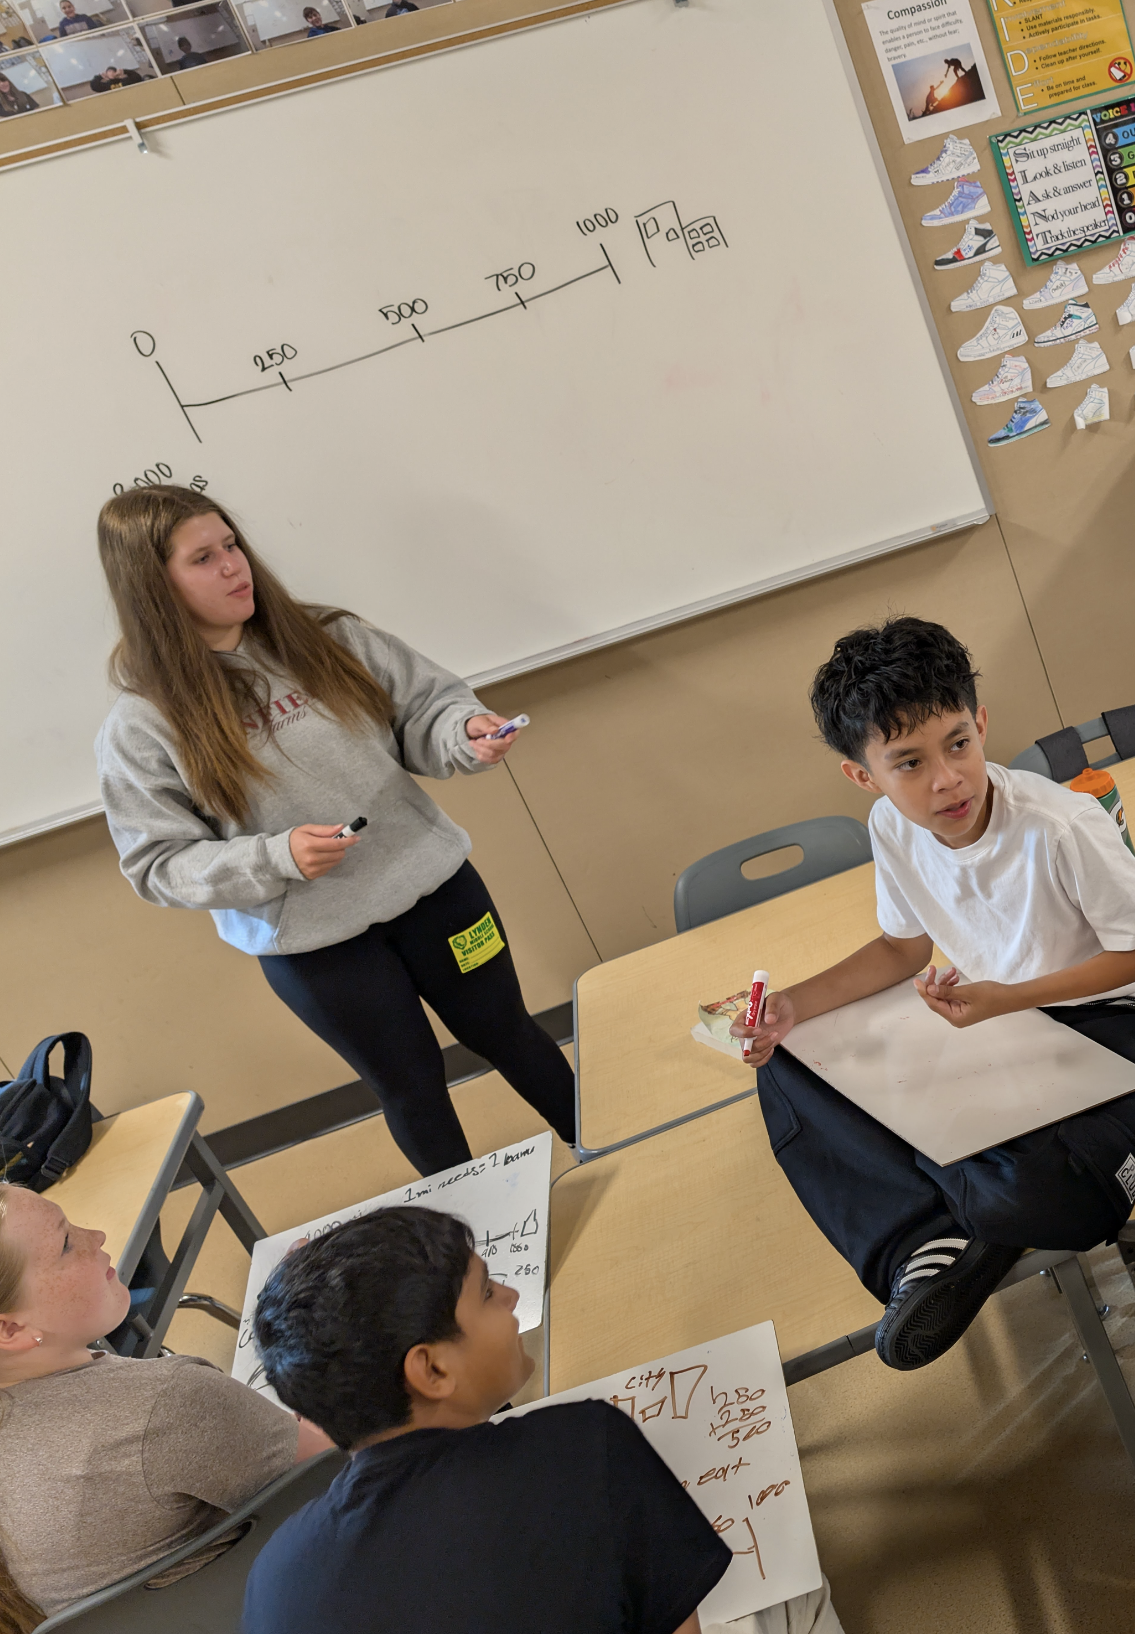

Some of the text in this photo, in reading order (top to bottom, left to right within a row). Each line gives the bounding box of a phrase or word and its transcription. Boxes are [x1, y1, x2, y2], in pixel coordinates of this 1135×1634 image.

[887, 0, 947, 20] Compassion
[1024, 13, 1043, 24] SLANT
[1028, 29, 1050, 38] Actively
[1051, 20, 1079, 33] participate
[1038, 17, 1063, 28] materials
[906, 30, 924, 40] person
[928, 32, 948, 41] without
[1039, 53, 1057, 62] Follow
[1058, 47, 1078, 56] teacher
[1041, 61, 1057, 69] Clean
[1076, 75, 1086, 83] and
[1048, 87, 1072, 99] prepared
[1093, 104, 1128, 123] VOICE
[1105, 134, 1116, 145] 4
[1013, 136, 1082, 165] Sit up straight
[1018, 157, 1087, 185] Look & listen
[1115, 173, 1128, 185] 2
[1052, 184, 1062, 196] &
[1062, 180, 1093, 195] answer
[1122, 192, 1131, 205] 1
[1031, 196, 1100, 227] Nod your head
[1126, 213, 1135, 224] 0
[576, 207, 620, 237] 1000
[1036, 219, 1109, 247] Track the speaker
[485, 262, 537, 292] 750
[379, 298, 429, 326] 500
[253, 343, 298, 374] 250
[469, 916, 492, 939] LYNDEN
[461, 930, 495, 956] VISITOR PASS
